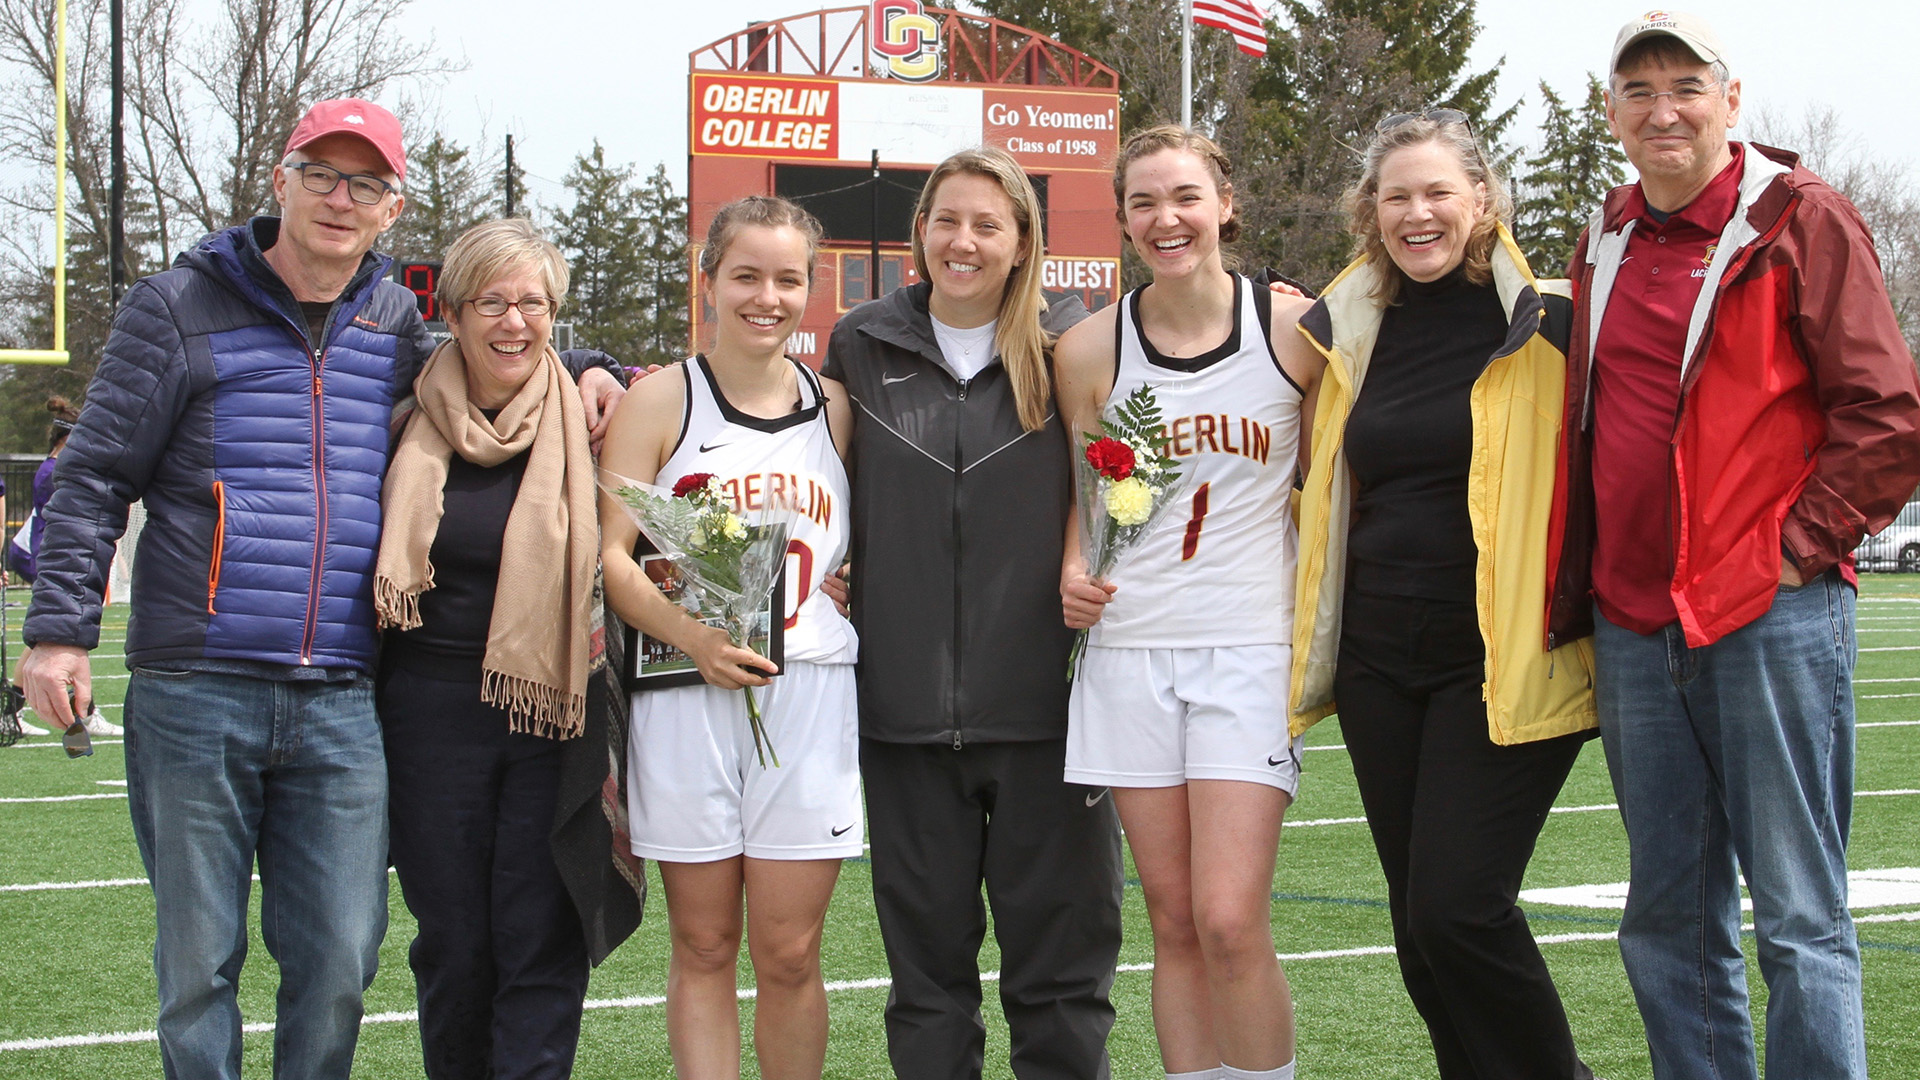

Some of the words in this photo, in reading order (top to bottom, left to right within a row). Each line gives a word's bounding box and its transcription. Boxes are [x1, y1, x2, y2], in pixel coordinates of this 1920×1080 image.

[1636, 21, 1679, 33] LACROSSE
[703, 84, 830, 117] OBERLIN
[987, 103, 1020, 126] Go
[1024, 105, 1114, 131] Yeomen!
[701, 118, 831, 150] COLLEGE
[1007, 137, 1044, 153] Class
[1047, 139, 1063, 154] of
[1065, 140, 1097, 155] 1958
[1041, 260, 1115, 289] GUEST
[786, 331, 816, 355] WN
[721, 472, 831, 532] BERLIN
[1181, 481, 1211, 562] 1
